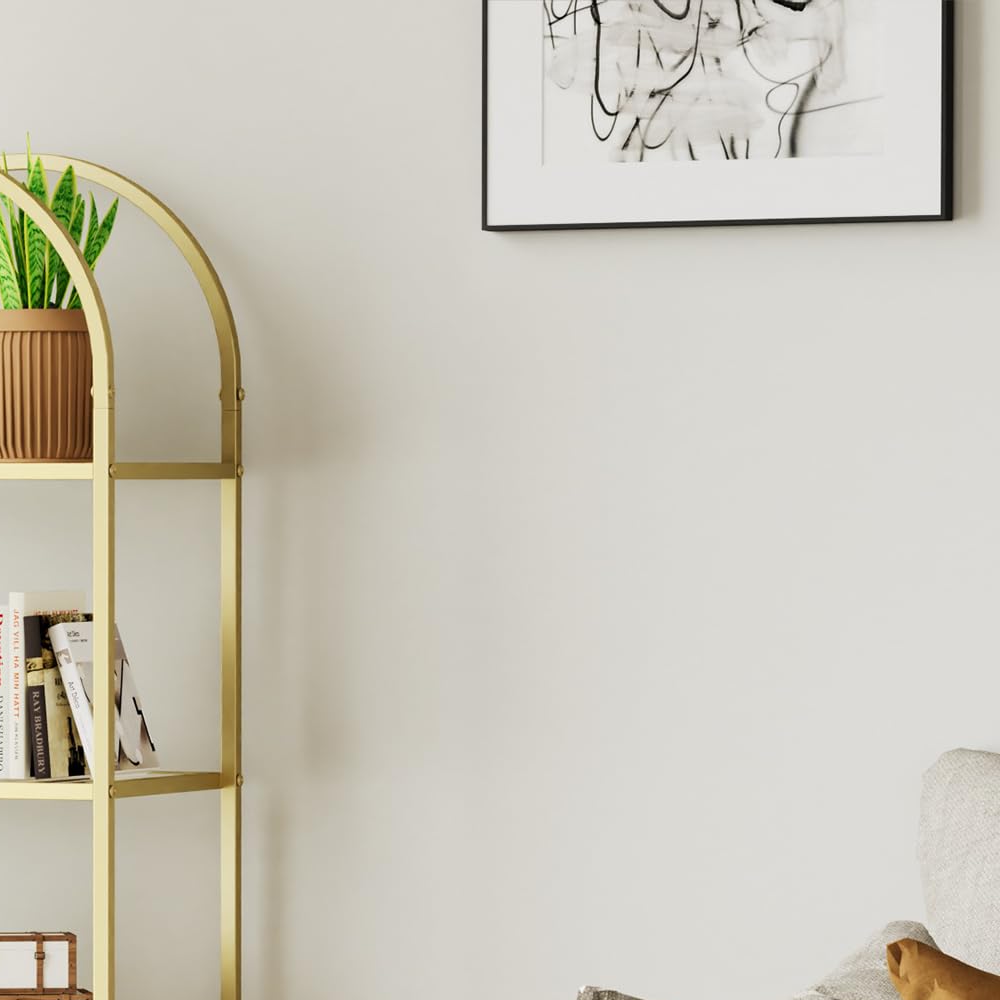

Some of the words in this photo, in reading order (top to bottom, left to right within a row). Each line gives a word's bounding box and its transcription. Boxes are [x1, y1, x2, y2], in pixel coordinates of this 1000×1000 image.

[13, 655, 20, 669] HA
[32, 691, 41, 712] RAY
[34, 715, 46, 775] BRADBURY
